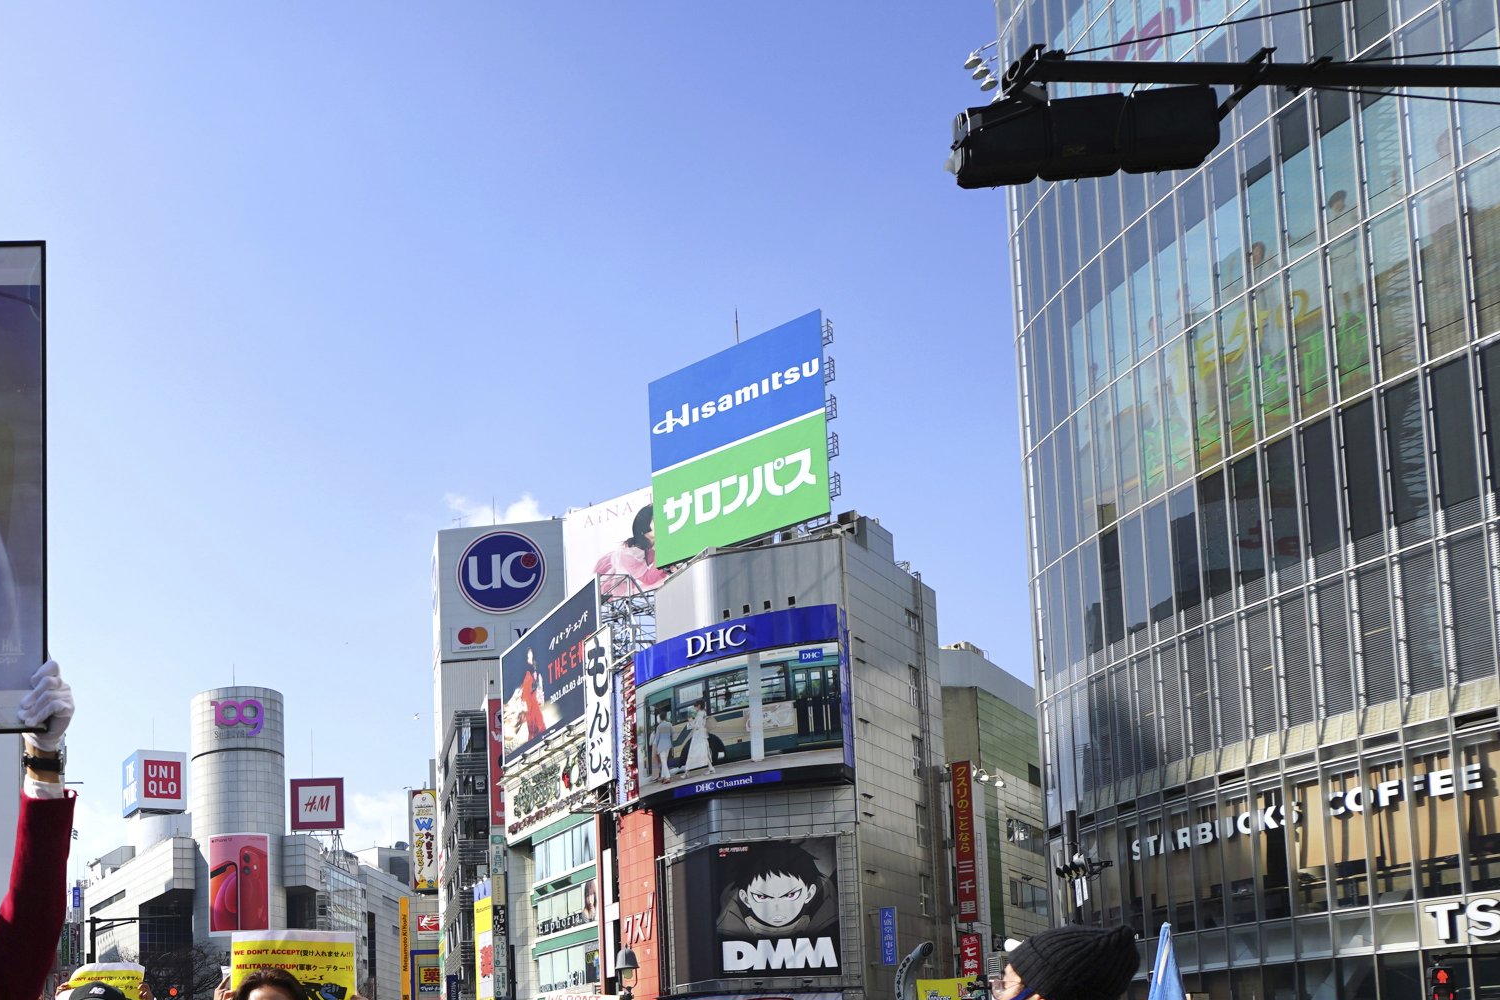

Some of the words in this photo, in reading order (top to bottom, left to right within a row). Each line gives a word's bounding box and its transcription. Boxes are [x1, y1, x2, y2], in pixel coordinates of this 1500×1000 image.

[653, 358, 820, 434] Hisamitsu
[663, 448, 816, 534] サロンパス
[571, 636, 591, 669] EN
[685, 624, 748, 658] DHC
[802, 651, 821, 659] DHC
[211, 699, 264, 737] 109
[587, 635, 611, 777] もんじゃ
[148, 764, 175, 779] UNI
[148, 780, 177, 796] QLO
[695, 782, 714, 793] DHC
[716, 776, 752, 789] Channel
[304, 795, 331, 813] H&M
[955, 765, 973, 853] クスリのことなら
[1329, 763, 1484, 820] COFFEE
[1132, 800, 1302, 861] STARBUCKS
[958, 860, 975, 914] 三千里
[538, 912, 581, 936] Euphoria
[624, 892, 654, 945] クスリ
[1426, 898, 1500, 941] TS
[722, 937, 838, 971] DMM
